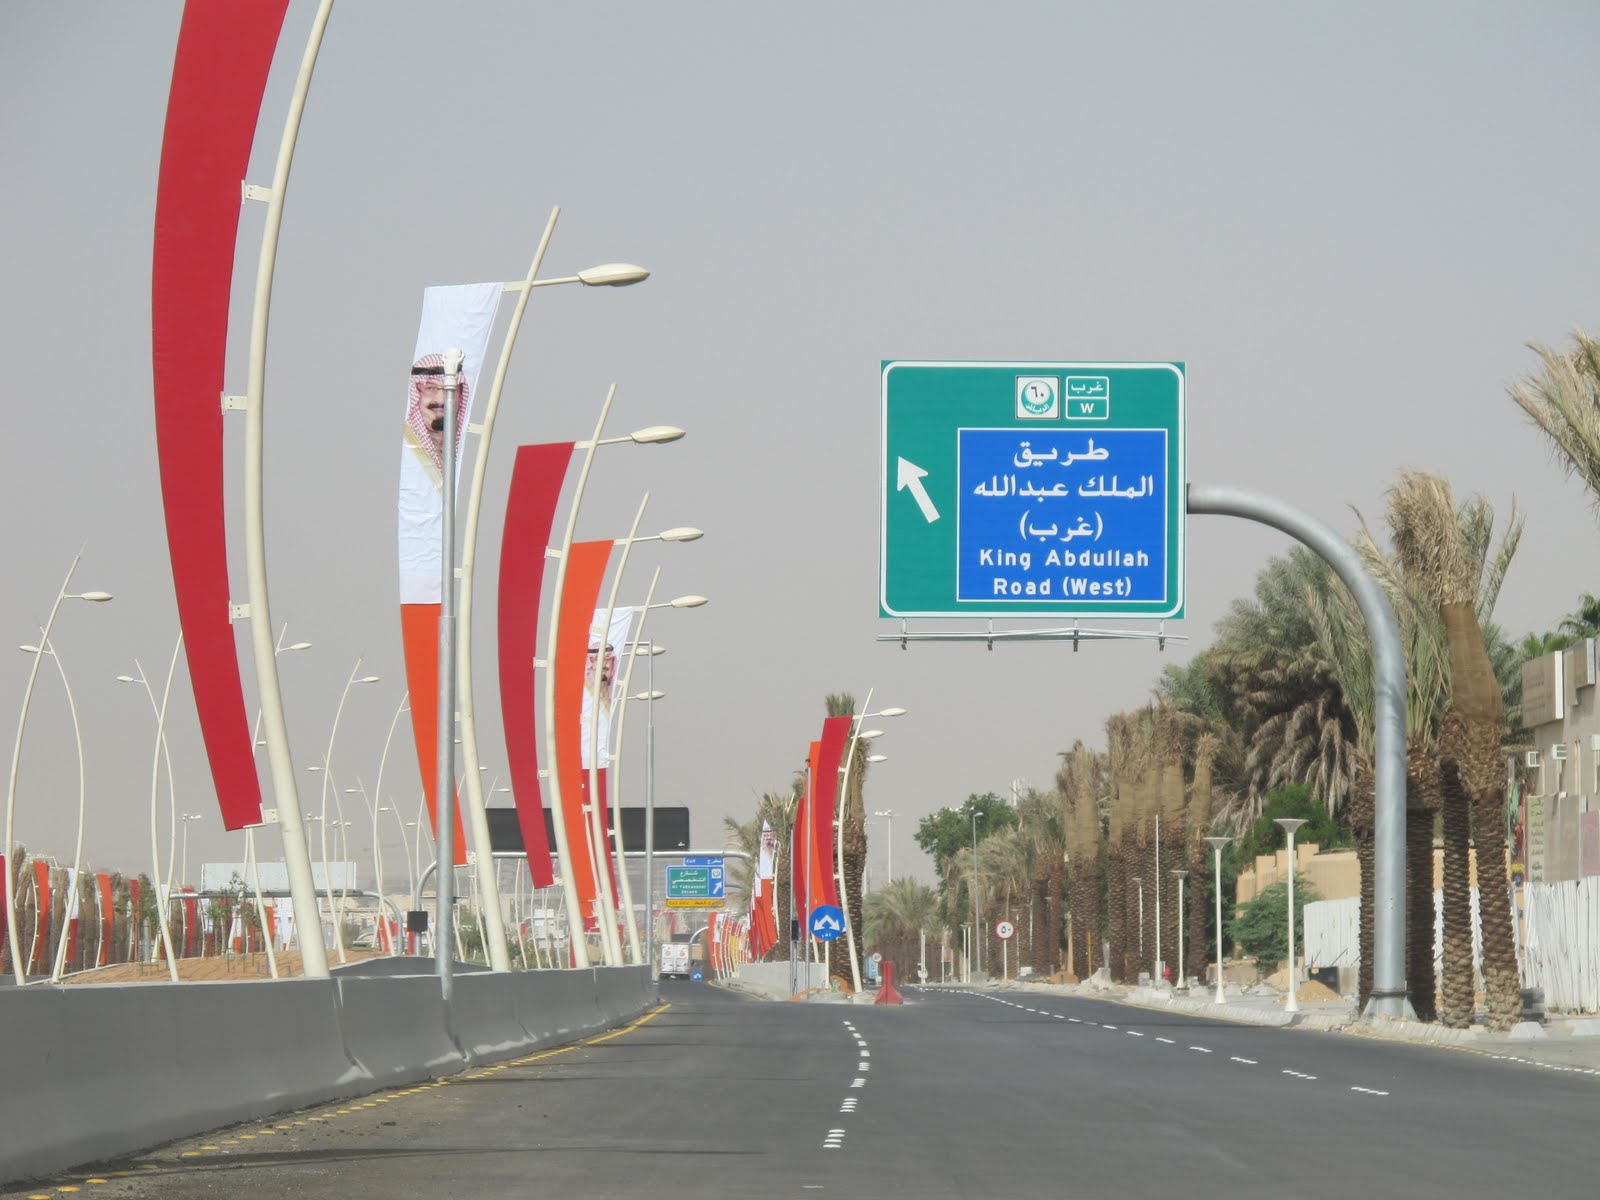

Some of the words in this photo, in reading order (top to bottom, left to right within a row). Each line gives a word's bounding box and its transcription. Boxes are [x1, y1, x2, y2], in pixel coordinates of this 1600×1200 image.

[1031, 385, 1044, 398] ٦٠
[1071, 381, 1104, 394] غرب
[1080, 402, 1094, 414] W
[1014, 438, 1109, 467] طريق
[974, 475, 1069, 503] عبدالله
[1079, 475, 1154, 499] الملك
[1020, 510, 1104, 542] (غرب)
[979, 549, 1031, 571] King
[1044, 549, 1149, 567] Abdullah
[993, 578, 1051, 595] Road
[1062, 577, 1131, 597] (West)
